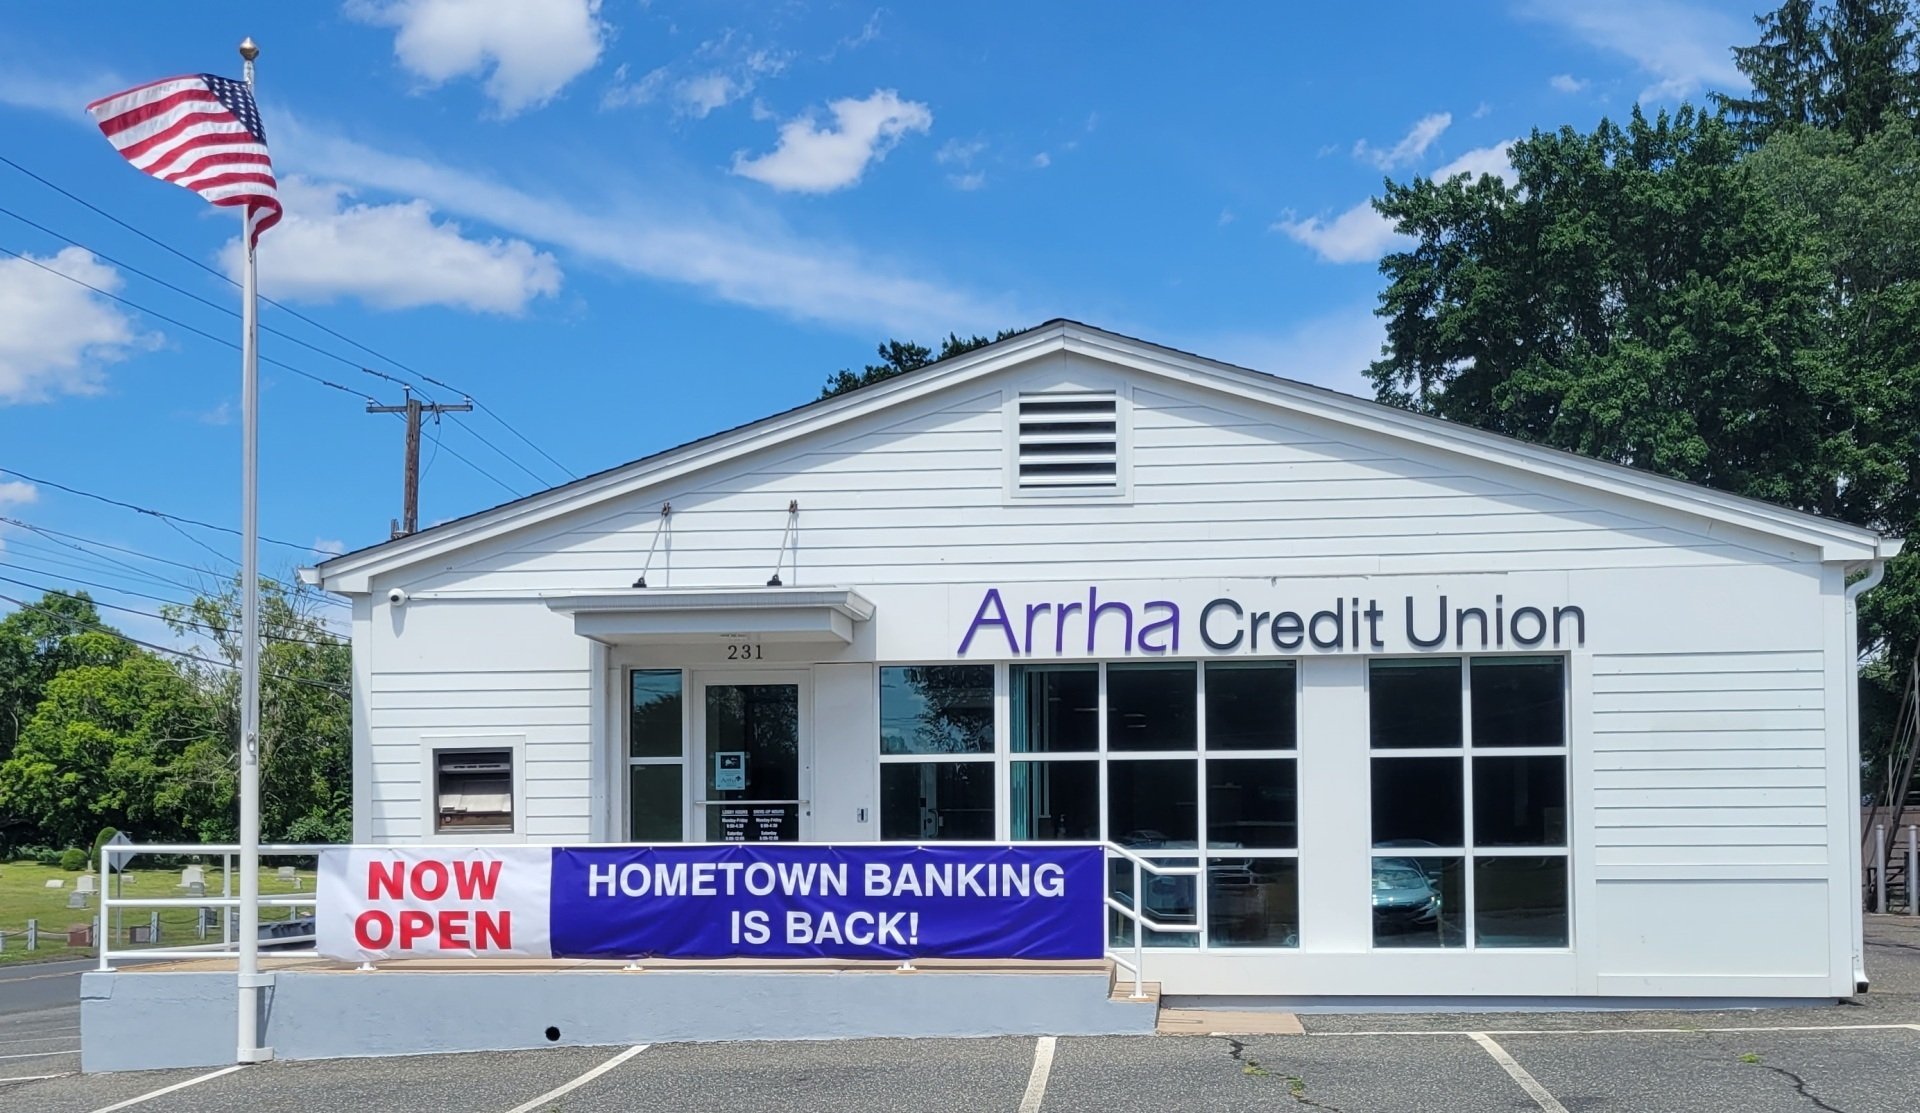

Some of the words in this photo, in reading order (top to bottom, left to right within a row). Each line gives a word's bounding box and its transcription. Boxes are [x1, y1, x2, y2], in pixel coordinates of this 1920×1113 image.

[957, 586, 1180, 654] Arrha
[1199, 597, 1384, 650] Credit
[1405, 594, 1585, 647] Union
[727, 644, 763, 660] 231
[367, 859, 503, 901] NOW
[588, 862, 848, 898] HOMETOWN
[864, 862, 1066, 898] BANKING
[354, 909, 512, 951] OPEN
[731, 911, 771, 945] IS
[786, 911, 919, 946] BACK!
